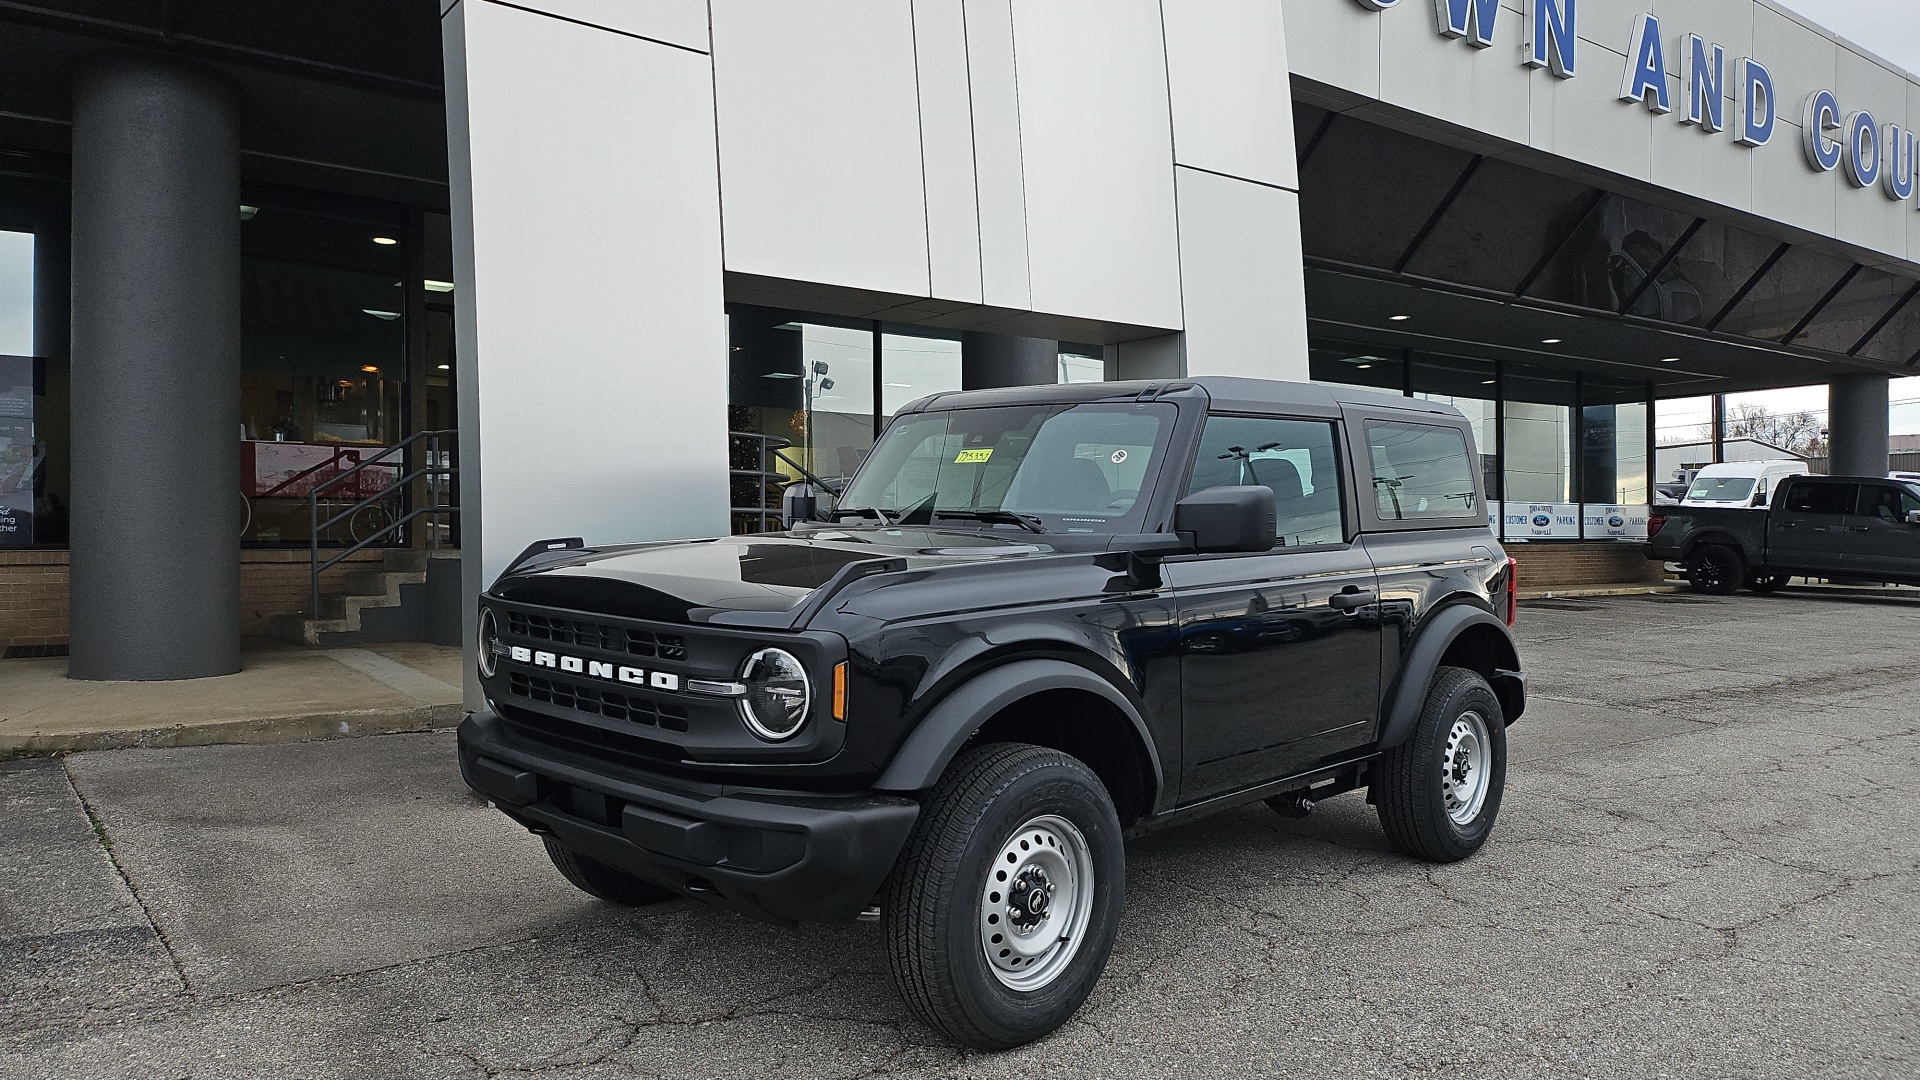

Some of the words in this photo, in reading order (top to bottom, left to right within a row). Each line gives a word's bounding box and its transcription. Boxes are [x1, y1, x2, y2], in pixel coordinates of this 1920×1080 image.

[1619, 12, 1776, 147] AND
[1802, 89, 1920, 207] COU
[0, 516, 16, 524] ing
[1506, 515, 1528, 525] CUSTOMER
[1556, 516, 1576, 525] PARKING
[1585, 516, 1604, 525] CUSTOMER
[1629, 516, 1647, 525] PARKING
[511, 646, 679, 691] BRONCO
